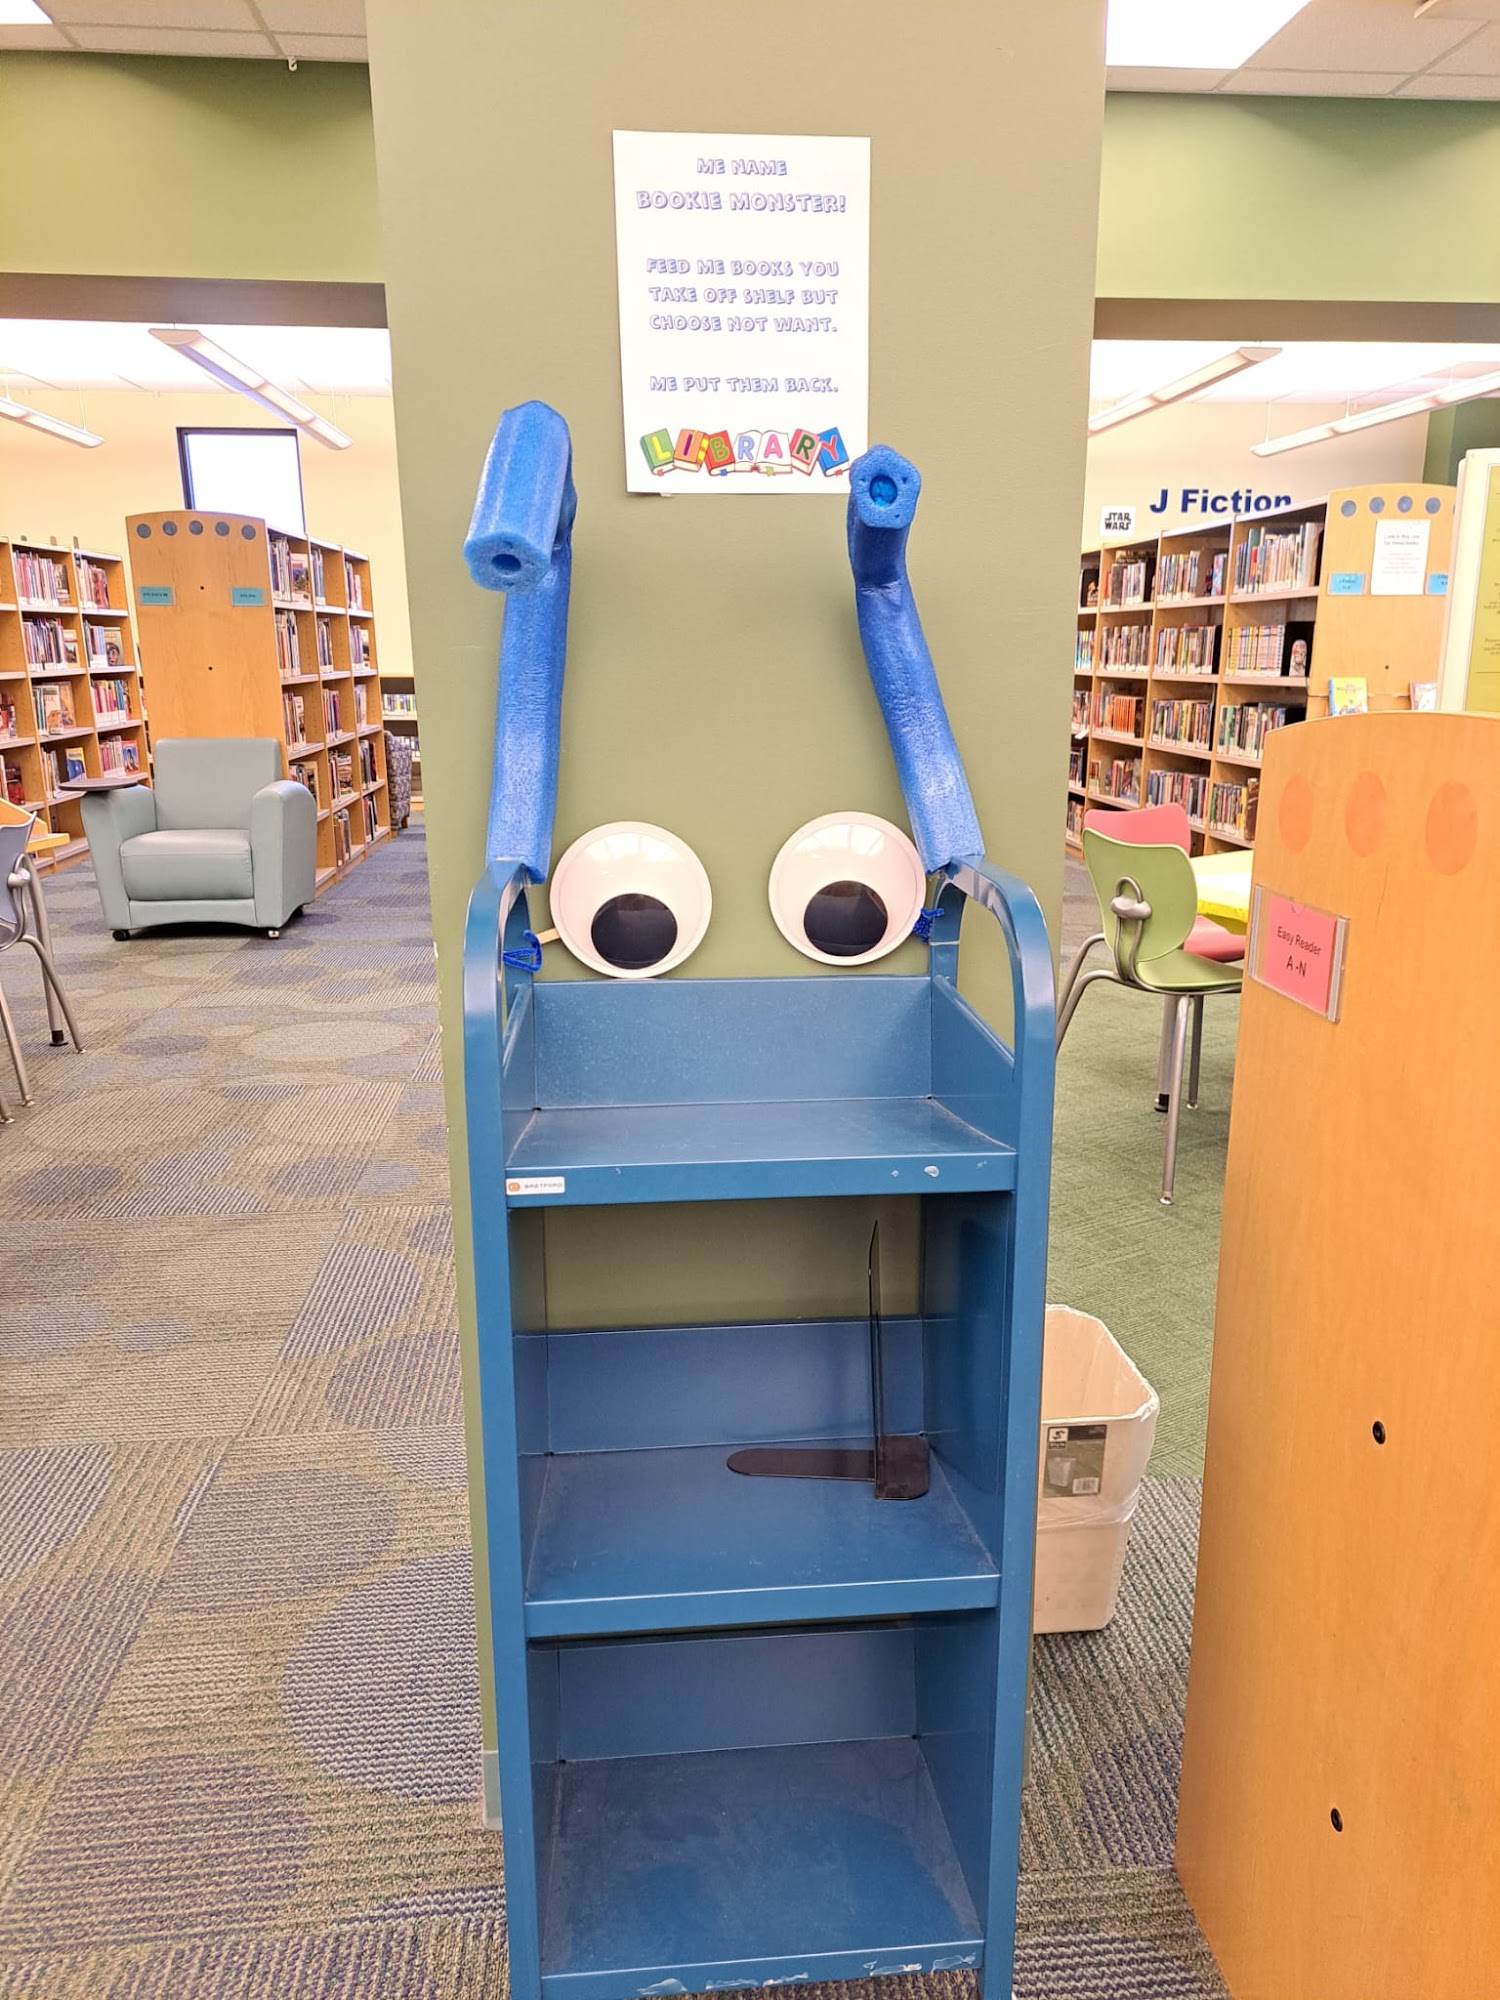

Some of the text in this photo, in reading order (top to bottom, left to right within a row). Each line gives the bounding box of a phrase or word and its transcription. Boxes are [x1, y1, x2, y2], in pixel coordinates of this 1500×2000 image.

[697, 158, 788, 176] ME NAME
[636, 190, 847, 213] BOOKIE MONSTER!
[646, 258, 840, 277] FEED ME BOOKS YOU
[648, 286, 839, 304] TAKE OFF SHELF BUT
[649, 315, 838, 332] CHOOSE NOT WANT.
[649, 376, 839, 392] ME PUT THEM BACK.
[648, 431, 841, 463] LIBRARY
[1149, 488, 1292, 514] J Fiction
[1104, 512, 1132, 521] STAR
[1104, 521, 1132, 531] WARS
[1277, 926, 1322, 956] Easy Reader
